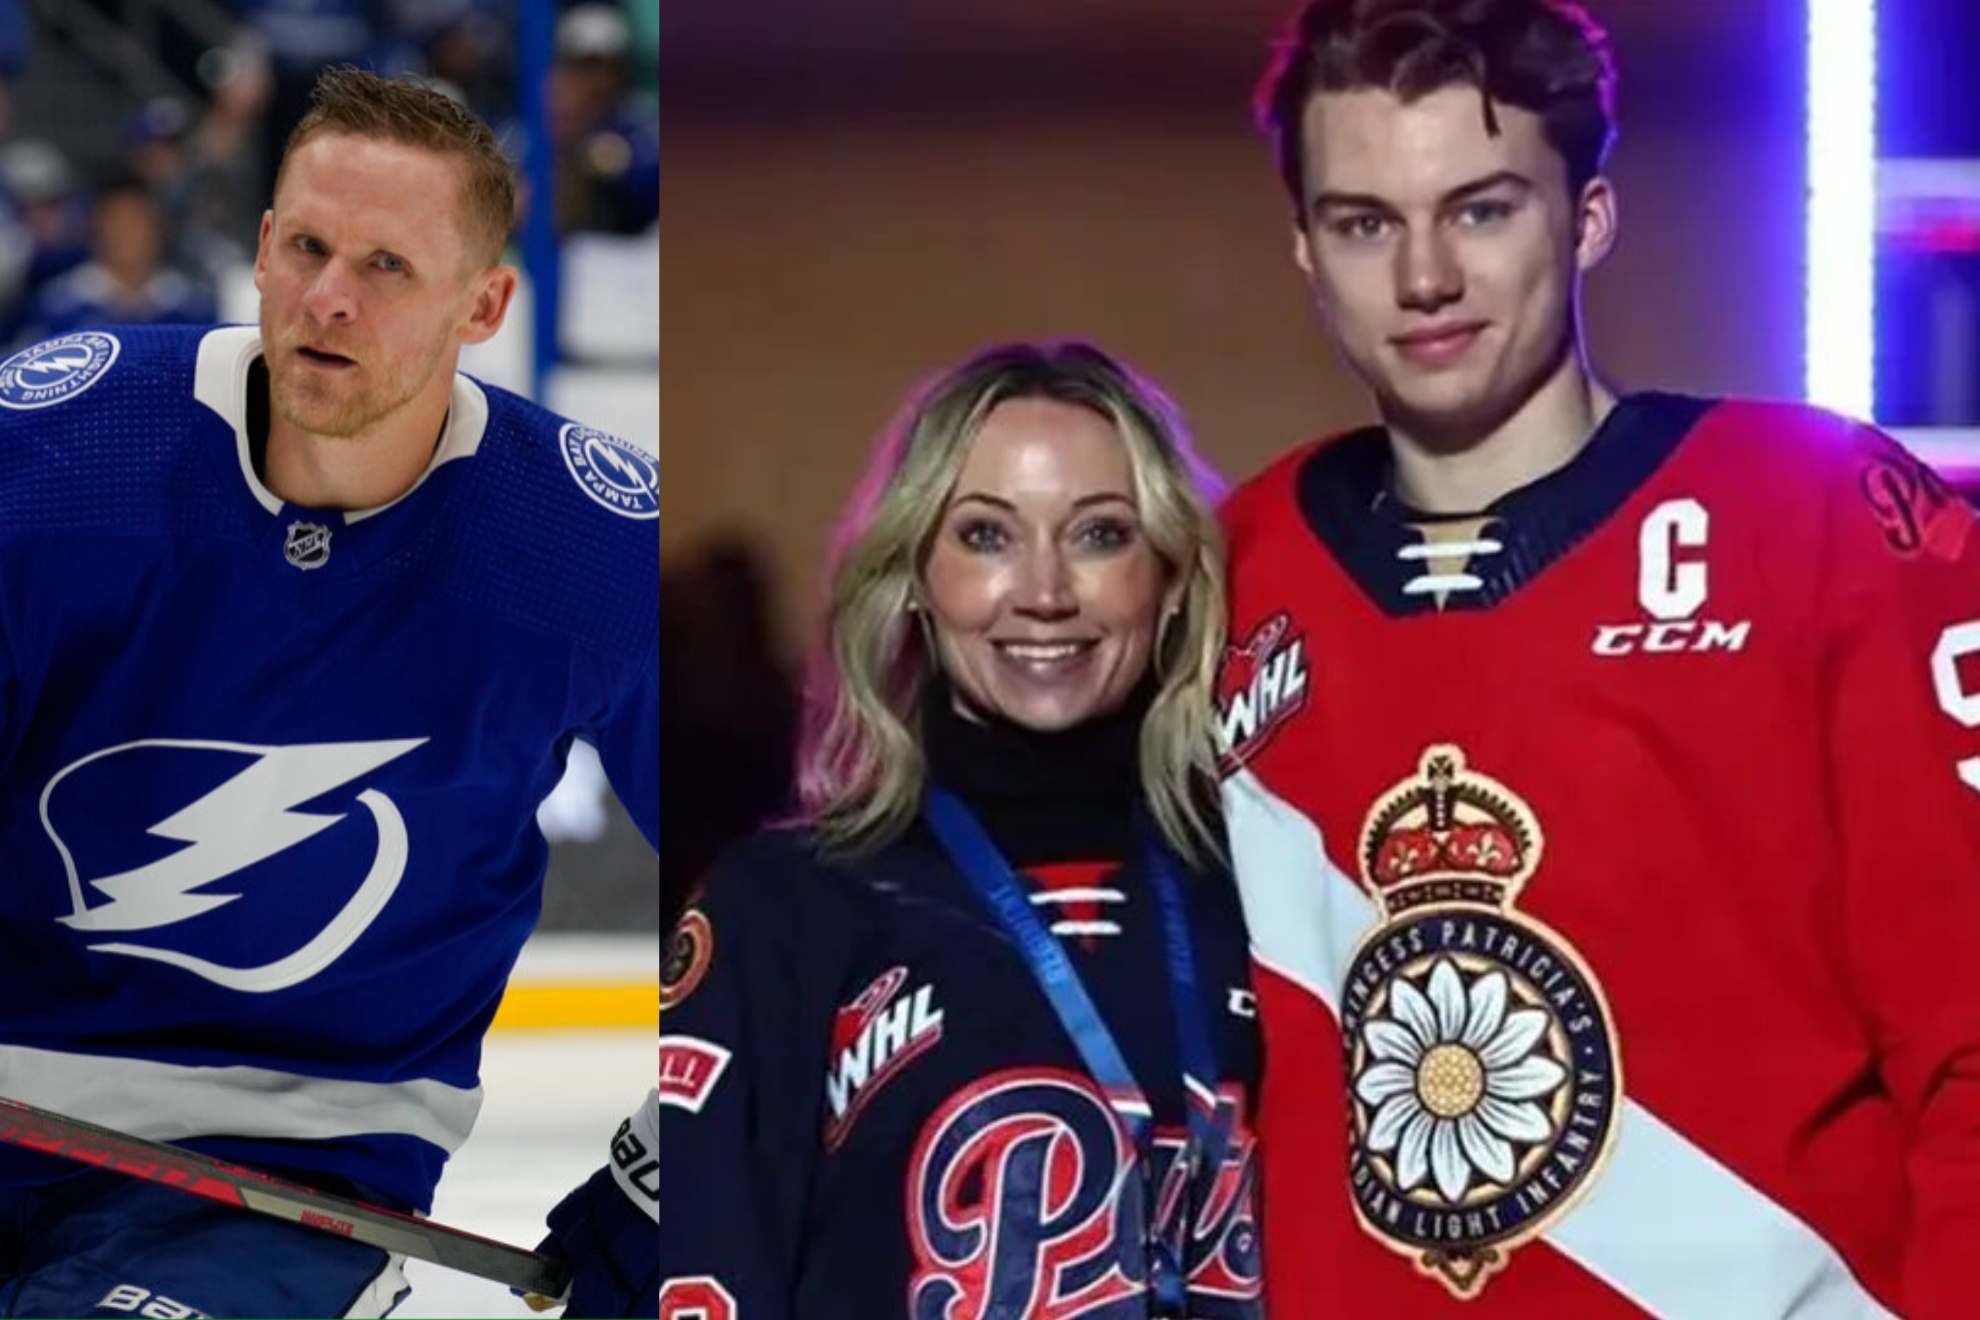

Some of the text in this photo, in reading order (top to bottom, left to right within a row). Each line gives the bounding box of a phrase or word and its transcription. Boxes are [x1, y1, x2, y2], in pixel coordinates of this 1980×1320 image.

[583, 469, 644, 510] TAMPA
[1638, 498, 1710, 620] C
[1591, 620, 1752, 656] CCM
[1214, 640, 1306, 757] WHL
[1441, 921, 1594, 1034] PATRICIA'S
[826, 984, 944, 1118] WHL
[1414, 1208, 1504, 1241] LIGHT
[1519, 1070, 1604, 1216] INFANTRY
